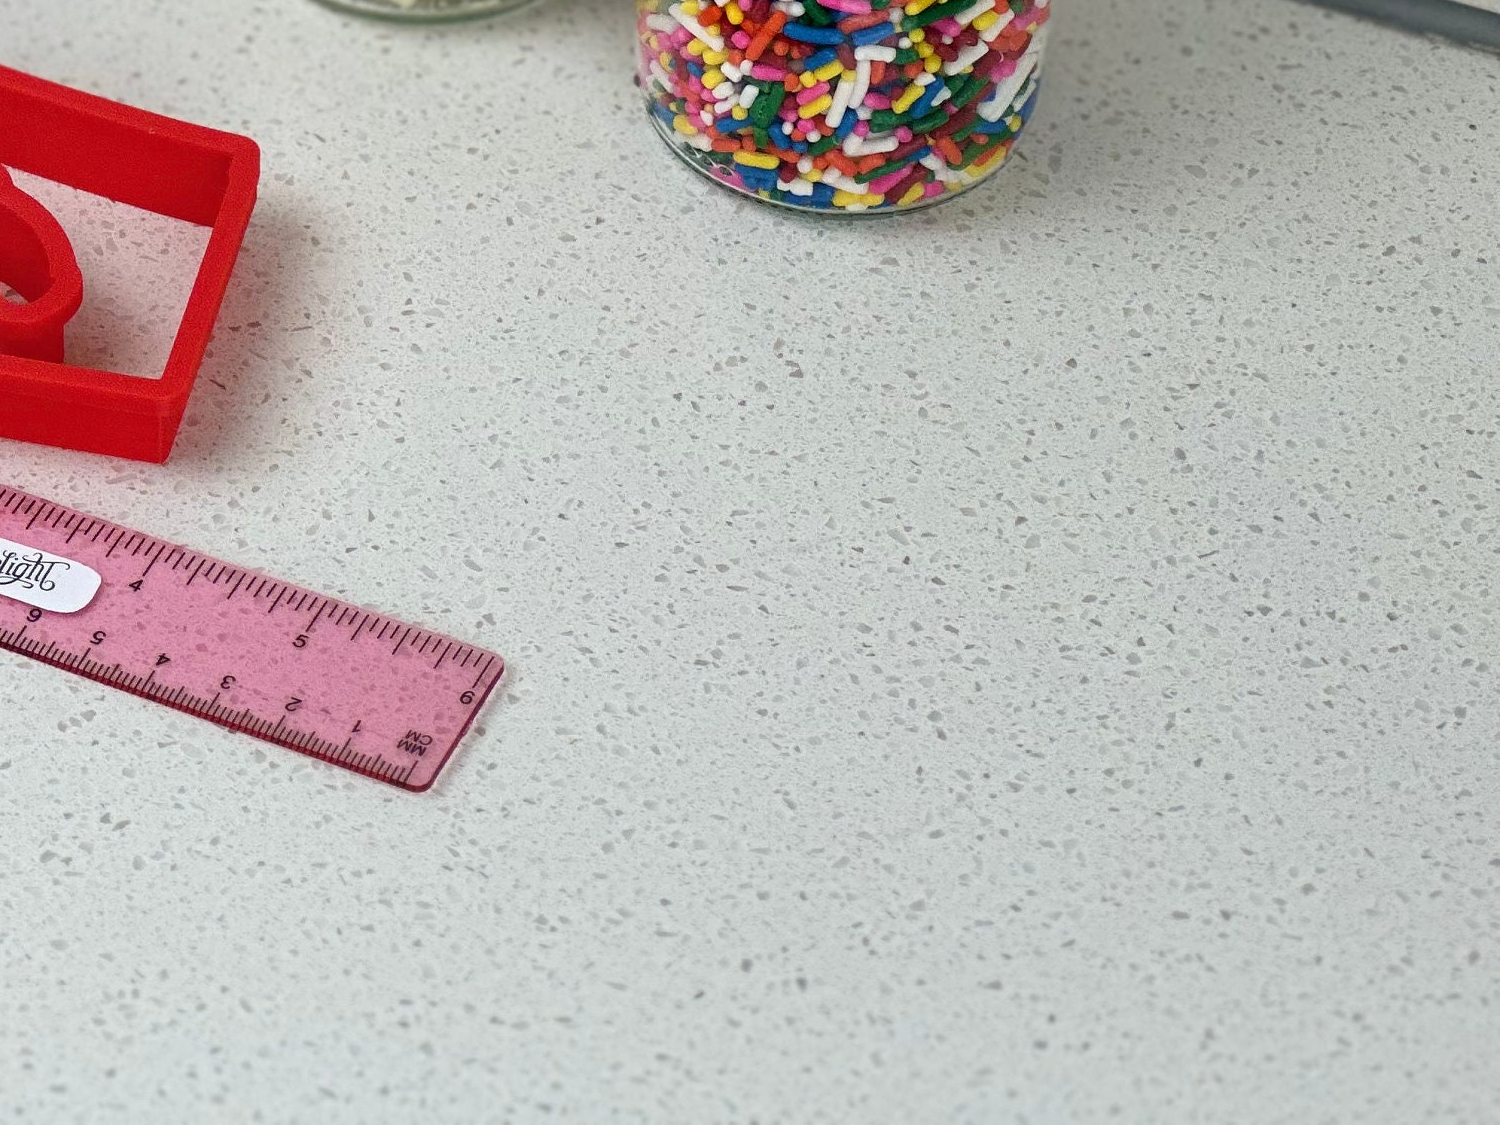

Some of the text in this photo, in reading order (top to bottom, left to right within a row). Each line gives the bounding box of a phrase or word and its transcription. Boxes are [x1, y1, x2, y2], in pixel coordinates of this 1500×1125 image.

[128, 579, 144, 592] 4
[292, 634, 309, 648] 5
[459, 690, 475, 705] 6
[90, 630, 106, 645] 5
[155, 653, 171, 666] 4
[220, 675, 236, 690] 3
[284, 696, 303, 712] 2
[351, 719, 362, 733] 1
[397, 739, 428, 757] MM
[405, 729, 433, 746] CM
